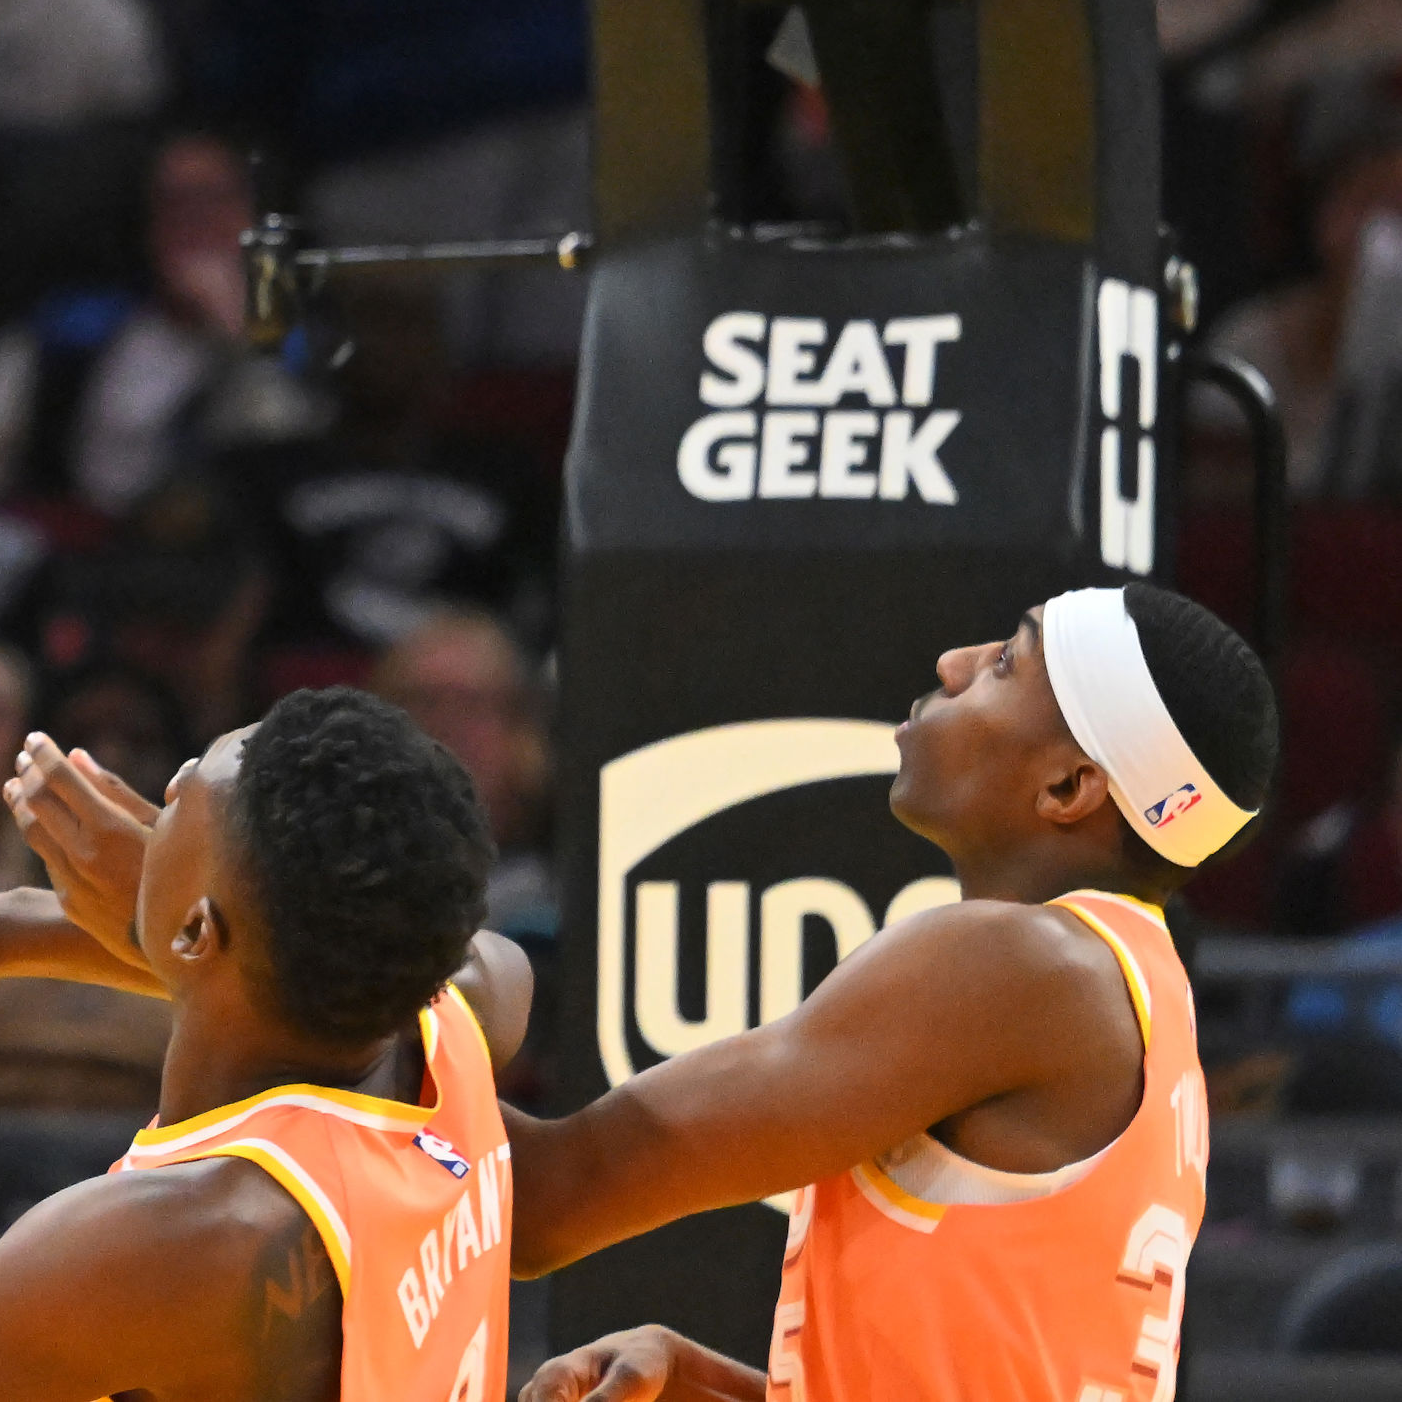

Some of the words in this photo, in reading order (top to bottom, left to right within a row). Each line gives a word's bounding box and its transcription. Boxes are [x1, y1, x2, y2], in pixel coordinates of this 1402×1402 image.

[698, 310, 962, 408] SEAT
[677, 409, 963, 505] GEEK
[634, 876, 963, 1060] up
